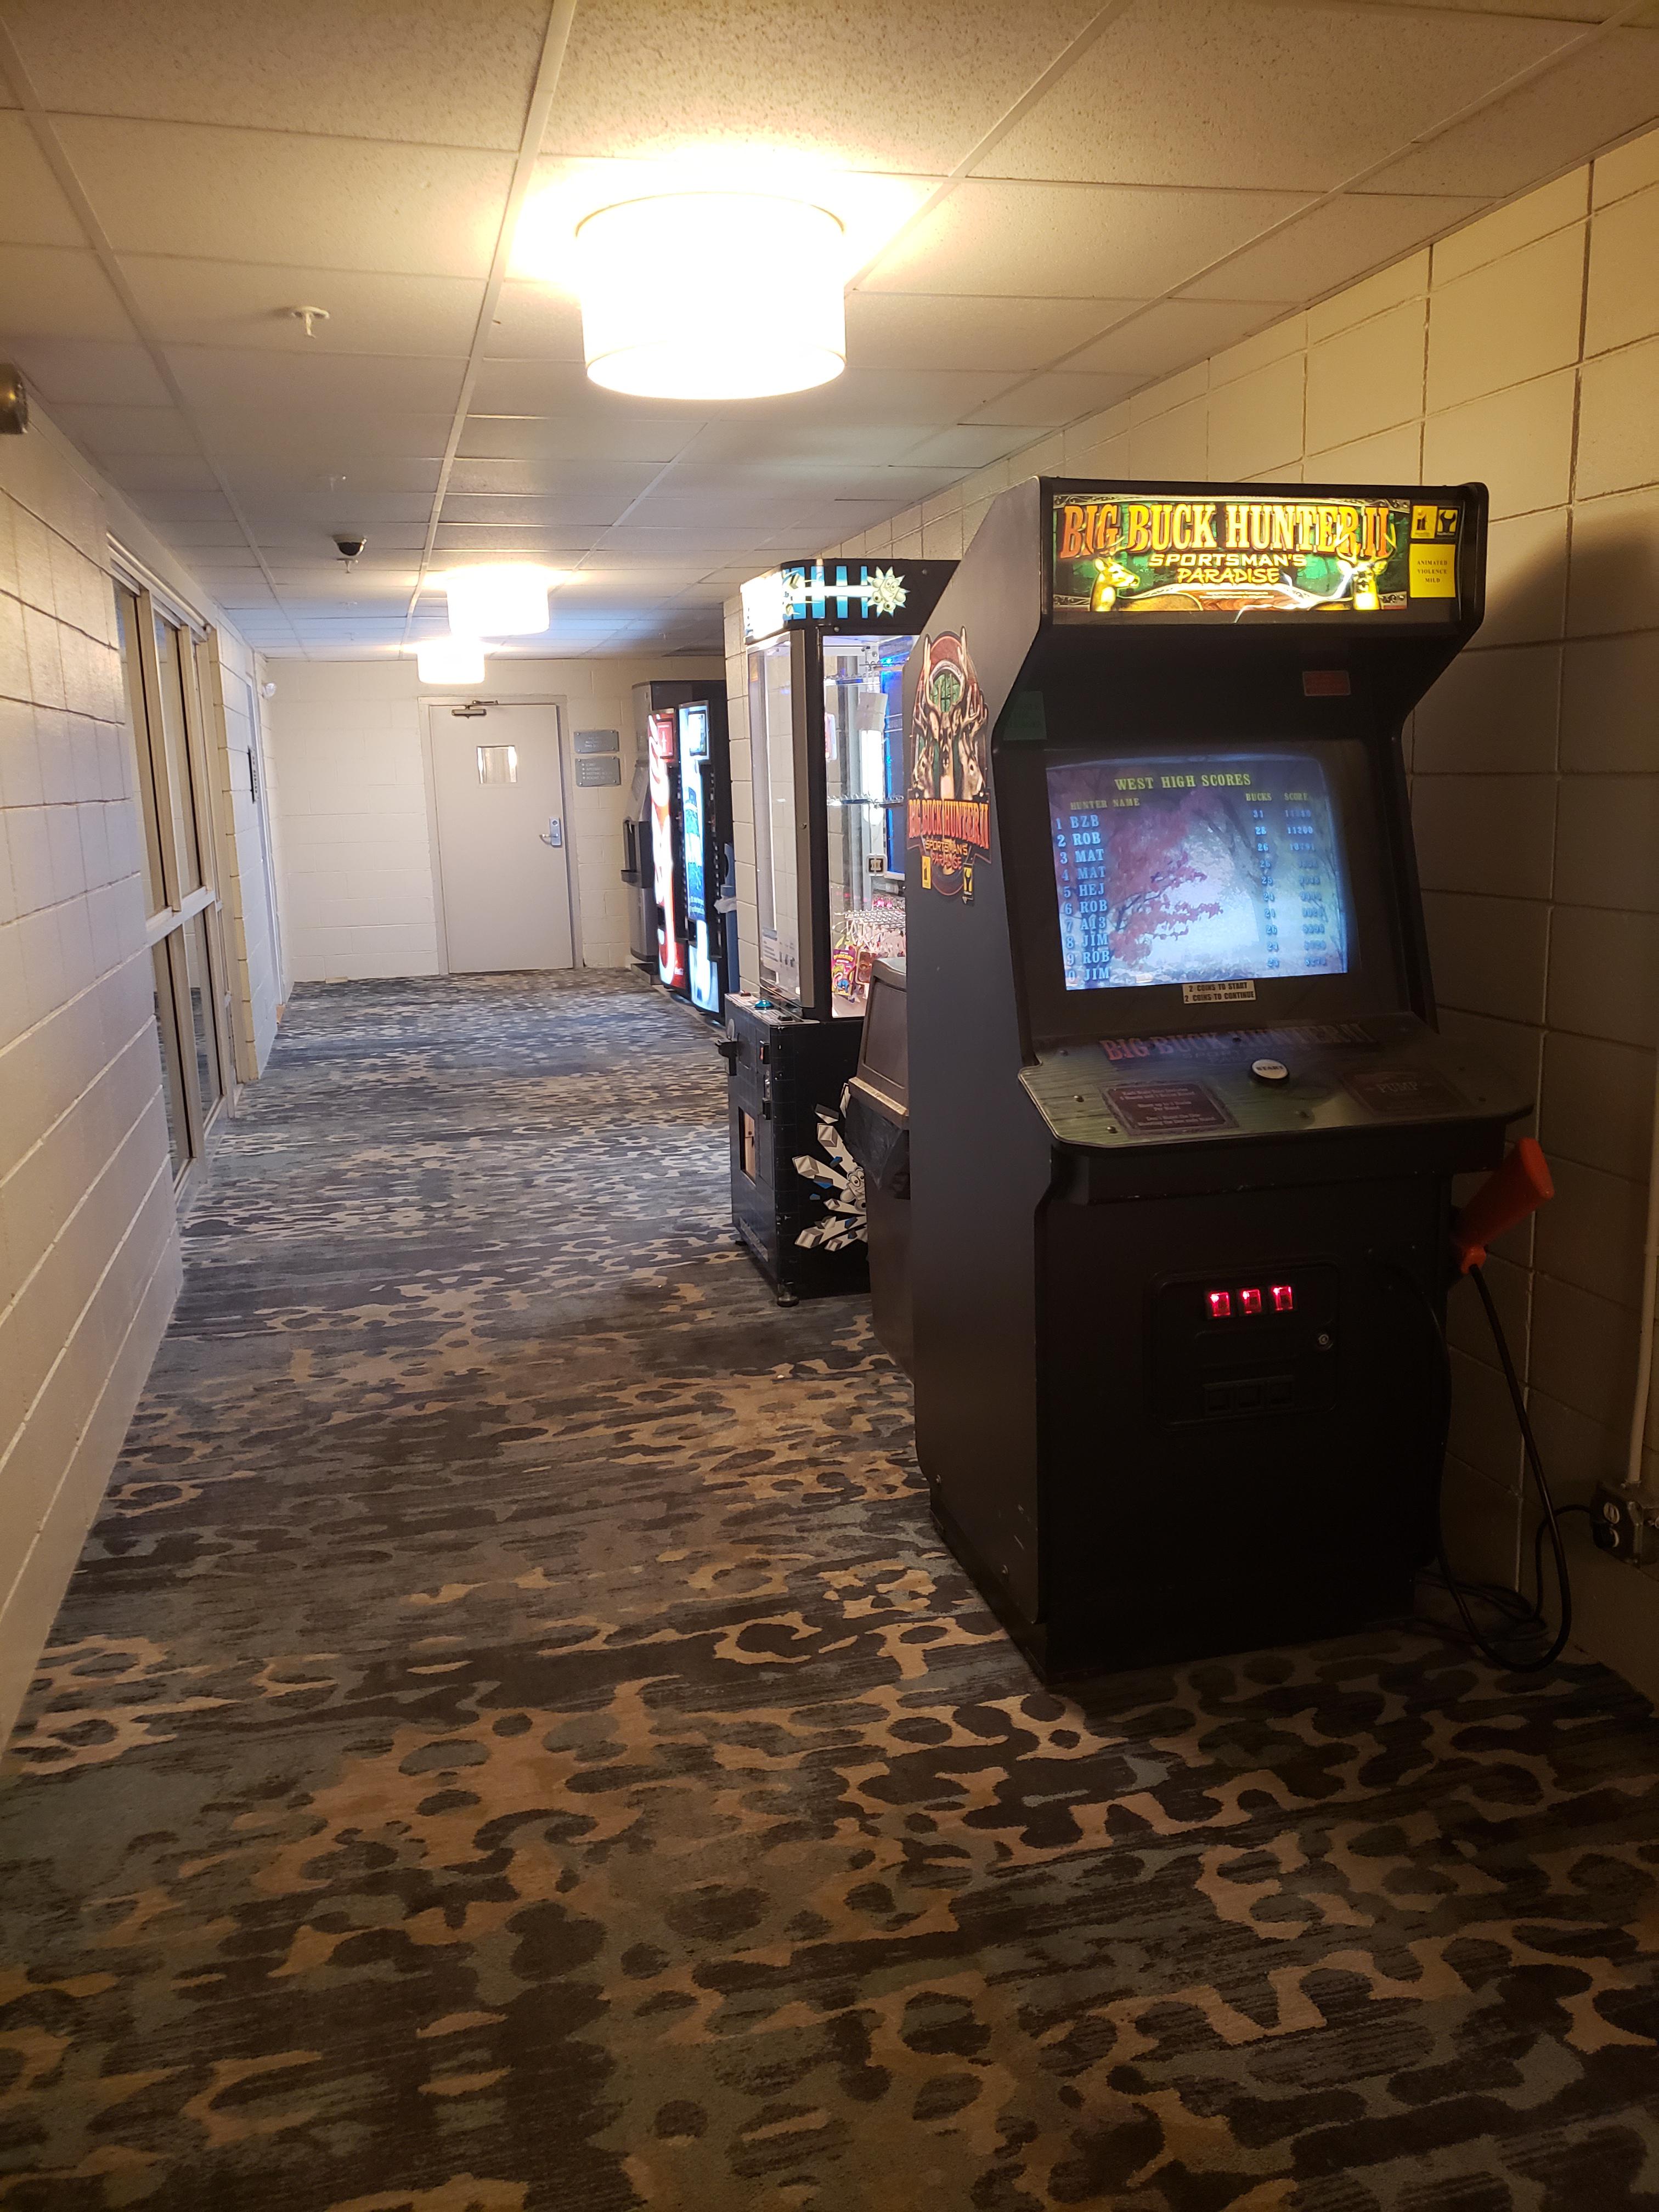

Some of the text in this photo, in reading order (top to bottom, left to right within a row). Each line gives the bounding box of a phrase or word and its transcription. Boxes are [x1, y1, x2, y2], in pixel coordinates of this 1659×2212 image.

[1059, 503, 1119, 558] BIG
[1126, 503, 1217, 553] BUCK
[1224, 504, 1361, 558] HUNTER
[1149, 553, 1307, 567] SPORTSMAN'S
[1176, 567, 1280, 584] PARADISE
[1114, 774, 1251, 791] WEST HIGH SCORES
[1070, 792, 1308, 810] HUNTER NAME BUCKS SCORE
[944, 800, 980, 846] HUNTER
[1056, 817, 1062, 830] 1
[1070, 814, 1099, 828] BZB
[1057, 834, 1066, 847] 2
[1072, 832, 1101, 845] ROB
[1060, 851, 1068, 864] 3
[1075, 849, 1104, 862] MAT
[1257, 843, 1269, 851] 26
[1062, 869, 1069, 881] 4
[1077, 866, 1106, 879] MAT
[1064, 886, 1071, 898] 5
[1079, 883, 1104, 896] HEJ
[1065, 903, 1072, 915] 6
[1080, 900, 1108, 913] ROB
[1065, 919, 1073, 932] 7
[1066, 936, 1074, 948] 8
[1082, 933, 1109, 947] JIM
[1066, 953, 1074, 966] 9
[1082, 950, 1110, 964] ROB
[1084, 967, 1110, 981] JIM
[1224, 991, 1255, 1000] CONTINUE
[1099, 1037, 1150, 1060] BIG
[1149, 1032, 1231, 1054] BUCK
[1376, 1081, 1418, 1093] PUMP
